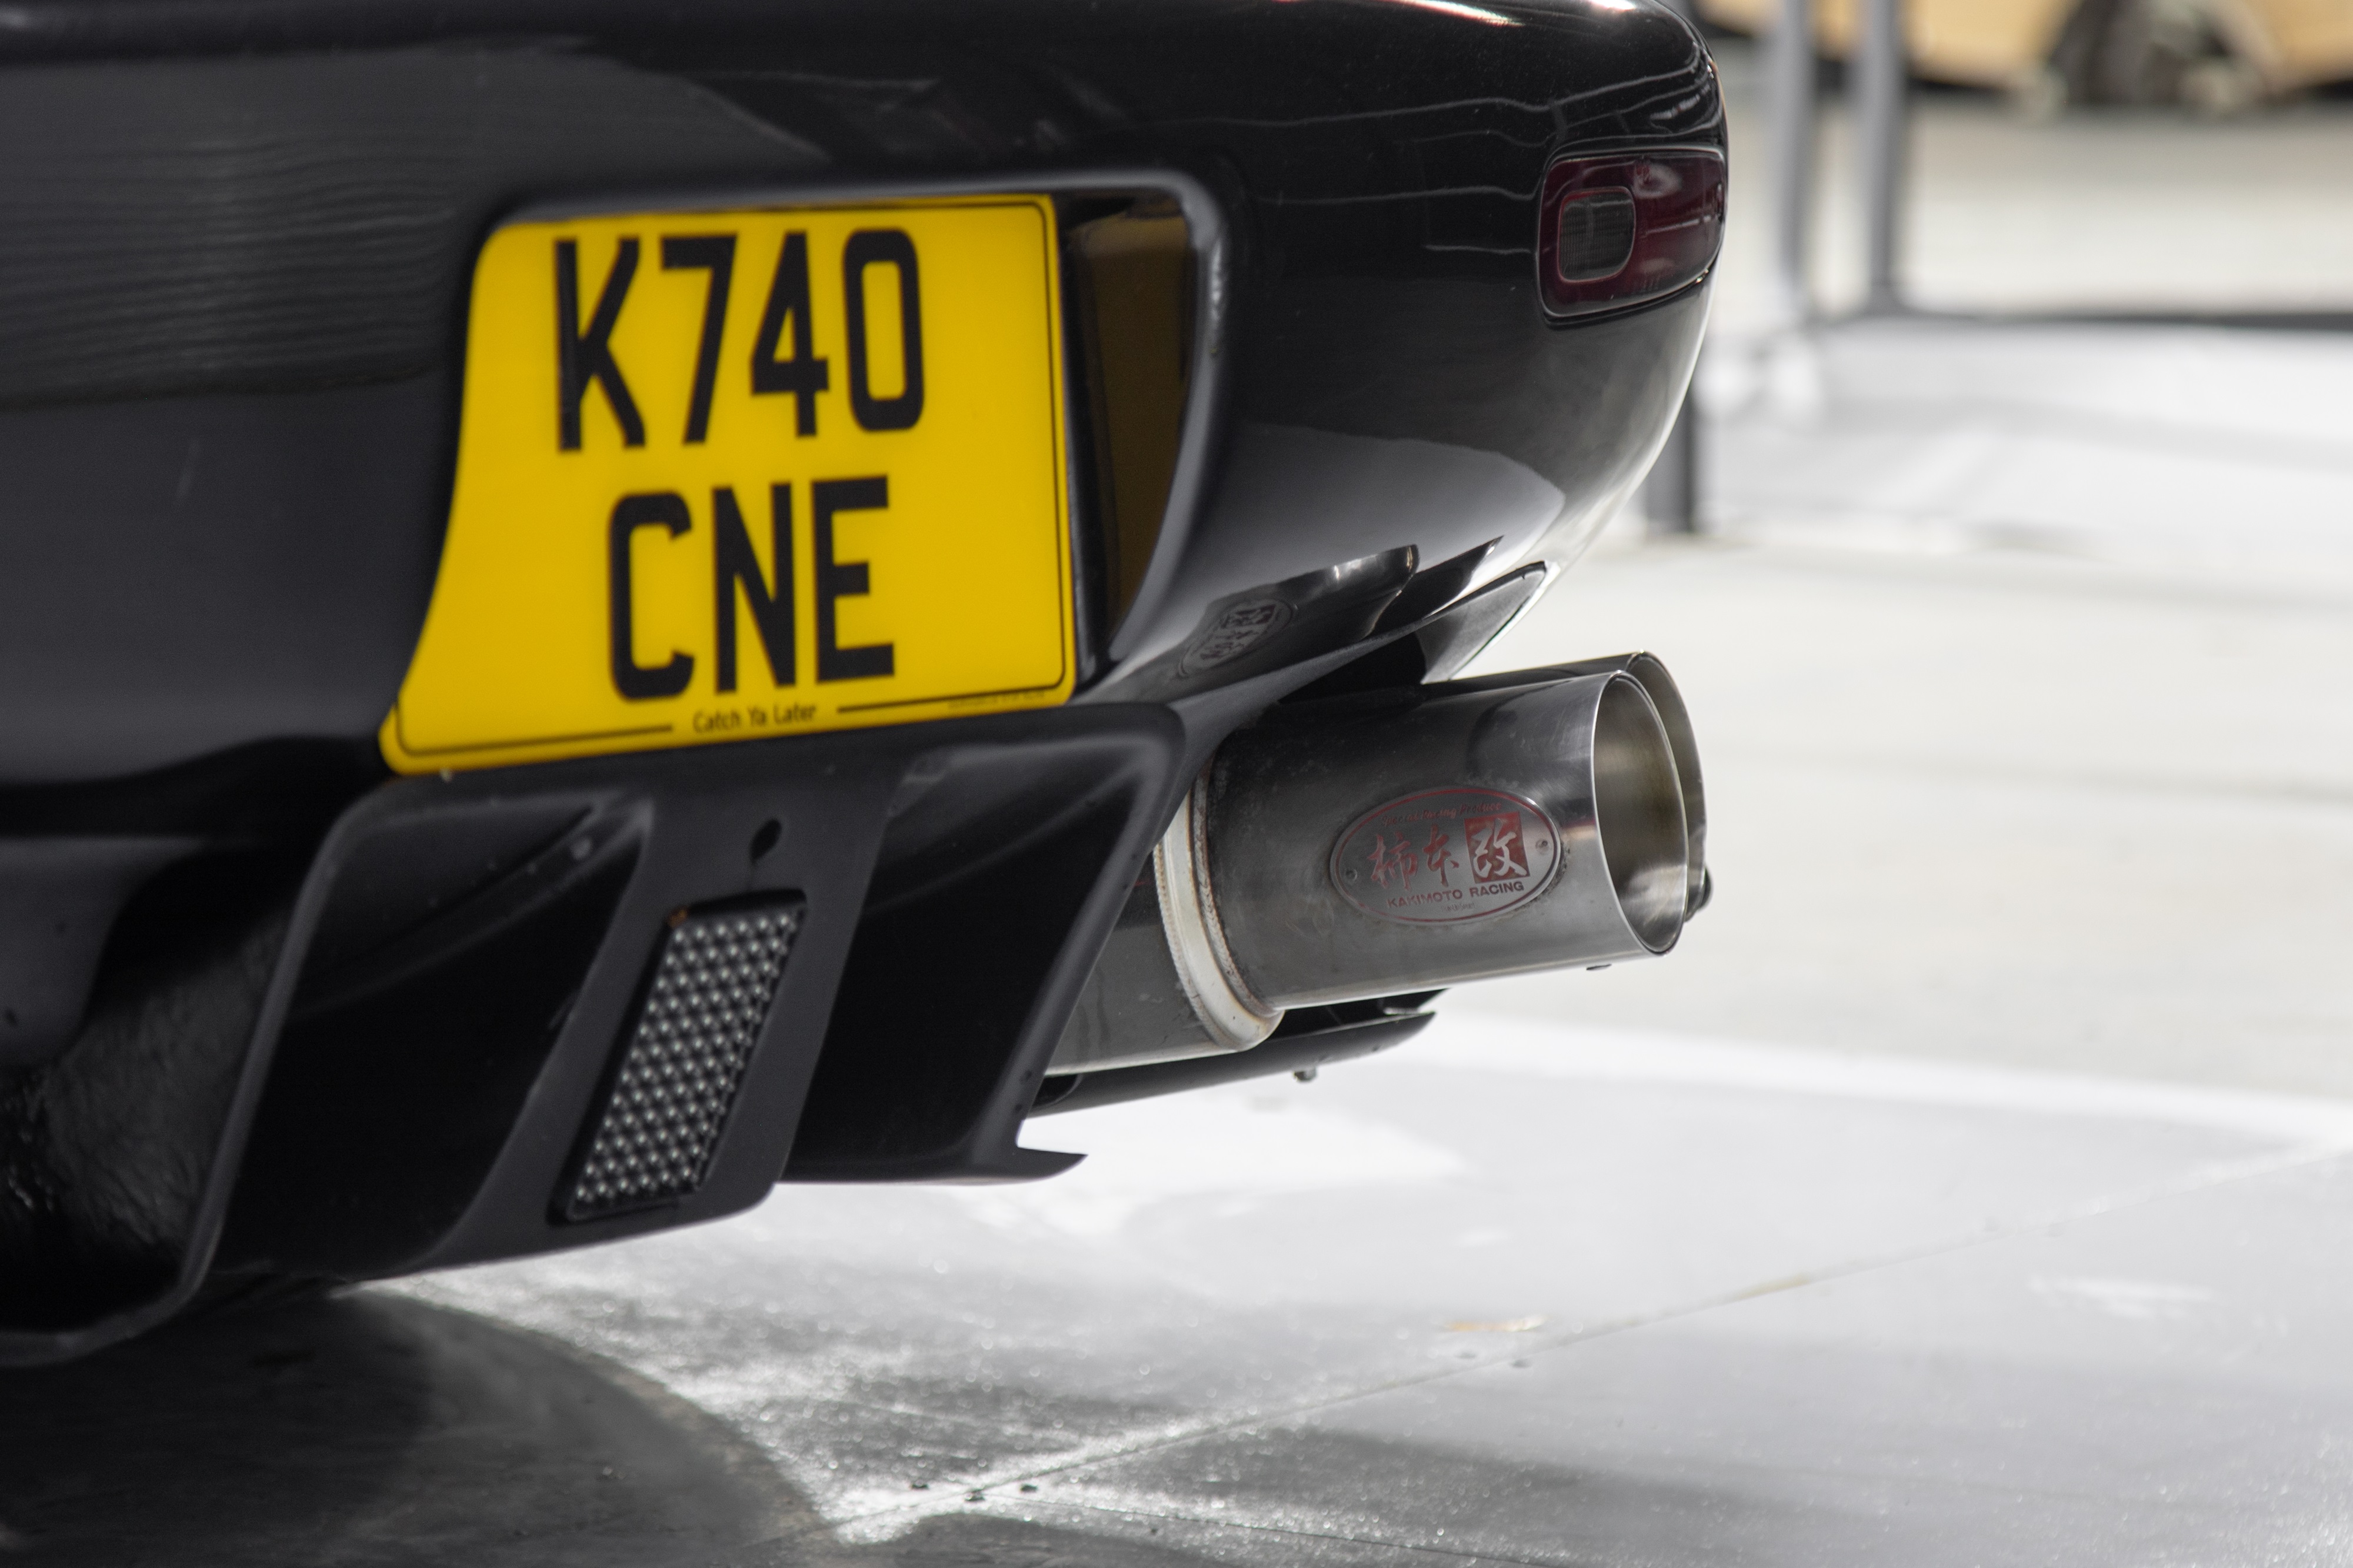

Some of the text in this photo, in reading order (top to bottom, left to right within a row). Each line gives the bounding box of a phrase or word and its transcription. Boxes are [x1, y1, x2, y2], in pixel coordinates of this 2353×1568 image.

[554, 226, 925, 453] K740
[608, 475, 896, 704] CNE
[692, 700, 817, 734] Catch Ya Later
[1387, 889, 1463, 909] KAKIMOTO
[1469, 880, 1525, 898] RACING
